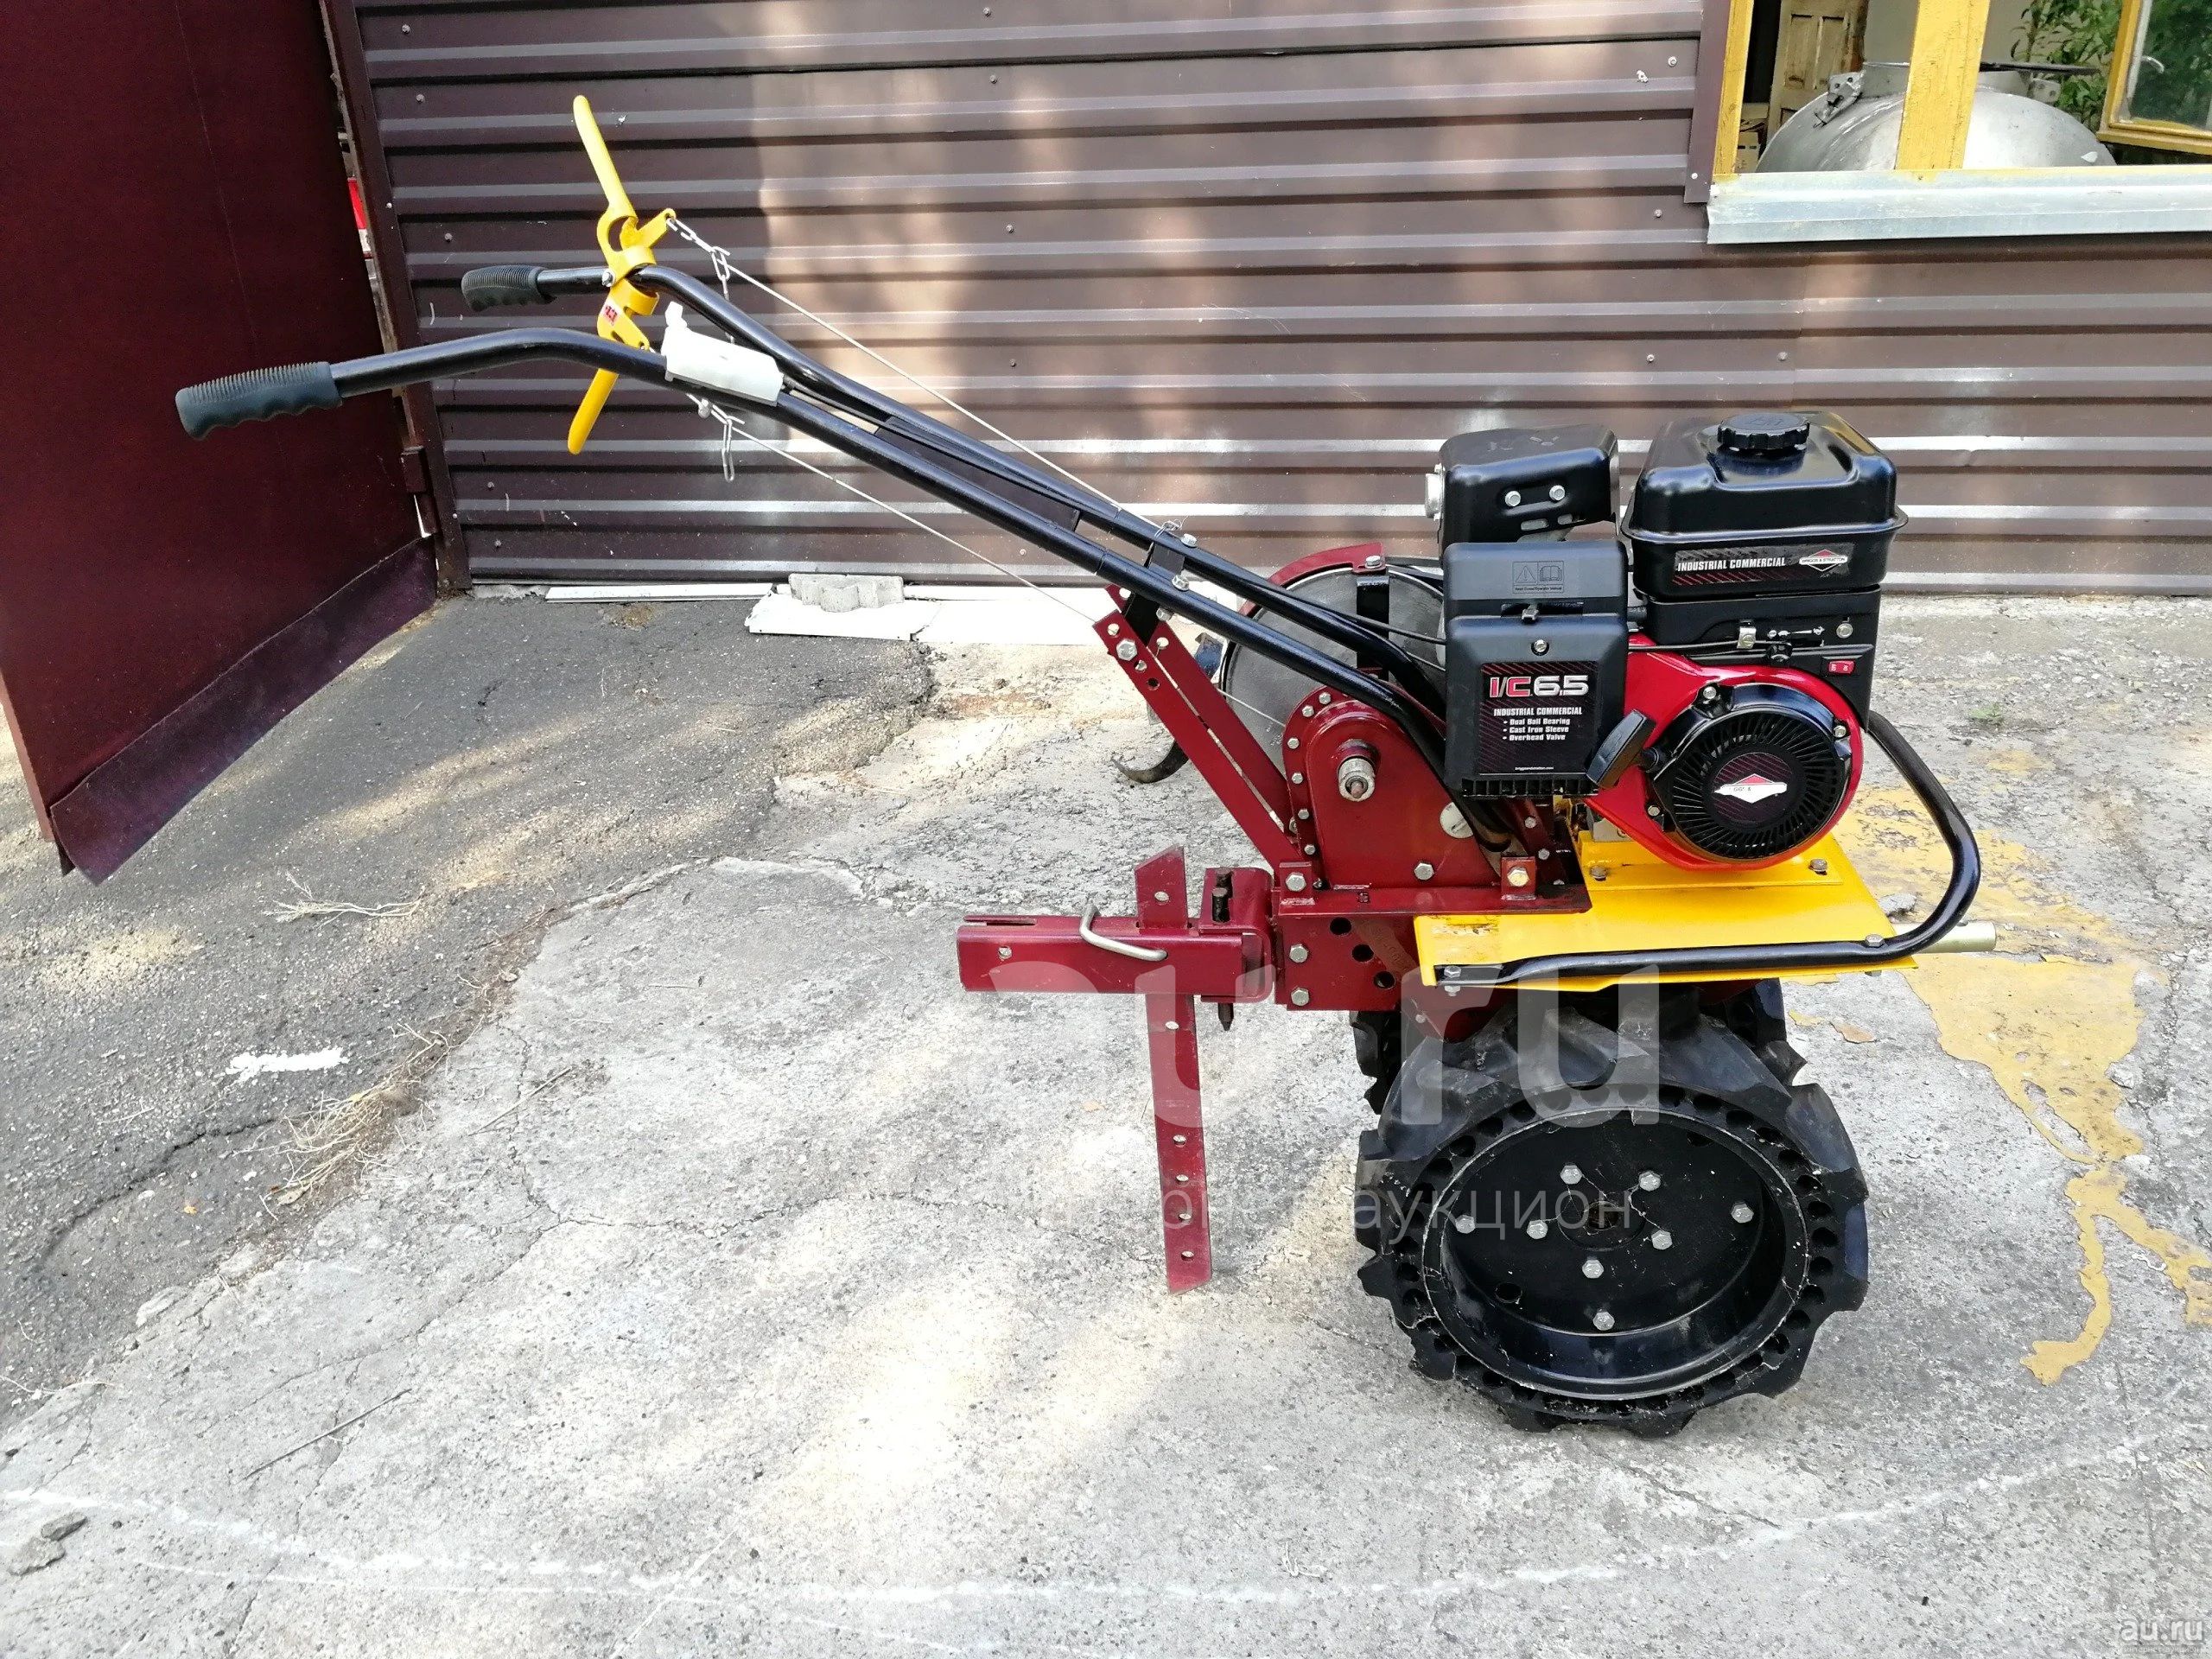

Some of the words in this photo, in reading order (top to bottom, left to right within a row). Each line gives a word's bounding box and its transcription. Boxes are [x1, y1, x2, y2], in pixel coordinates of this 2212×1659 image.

[1677, 560, 1727, 572] INDUSTRIAL
[1729, 557, 1786, 569] COMMERCIAL
[1493, 708, 1535, 717] INDUSTRIAL
[1536, 707, 1583, 716] COMMERCIAL
